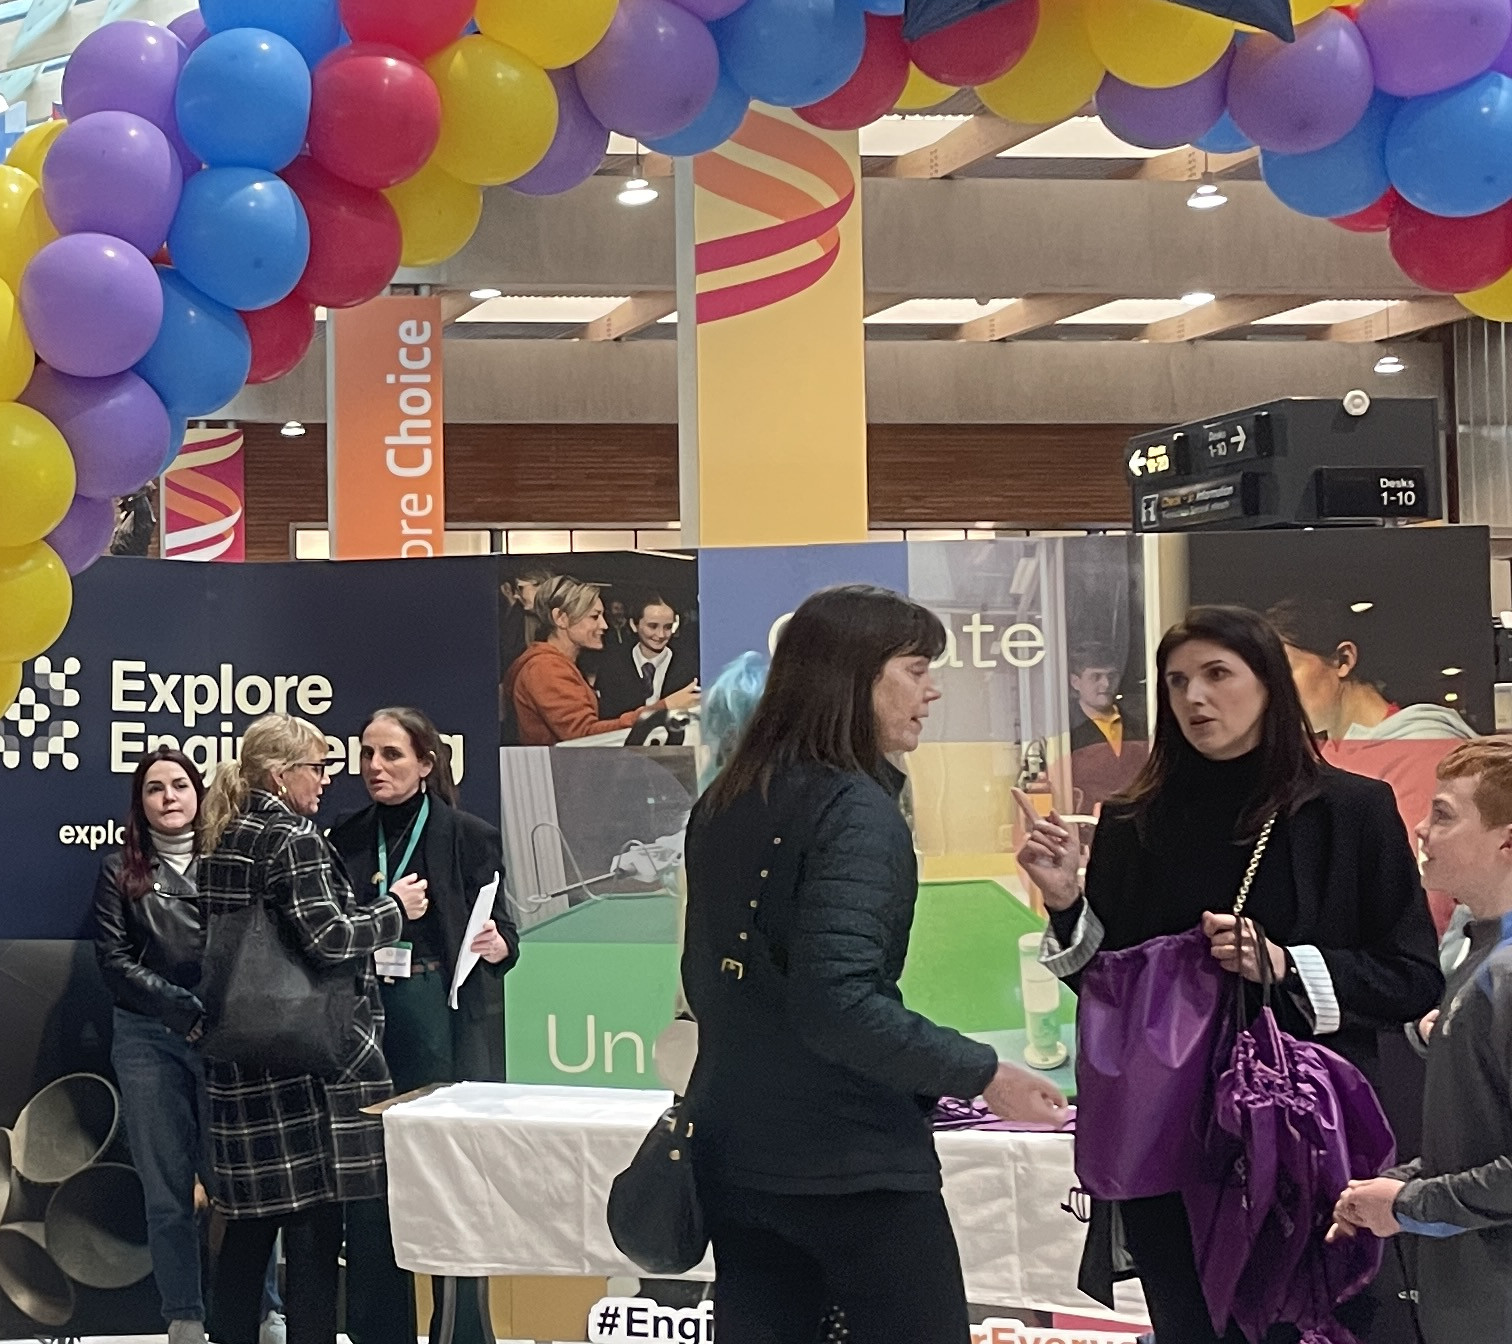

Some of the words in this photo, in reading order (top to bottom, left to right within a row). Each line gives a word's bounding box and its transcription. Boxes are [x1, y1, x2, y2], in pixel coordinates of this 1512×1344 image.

[384, 318, 432, 478] Choice
[1379, 477, 1416, 489] Desks
[1380, 490, 1416, 506] 1-10
[110, 659, 334, 728] Explore
